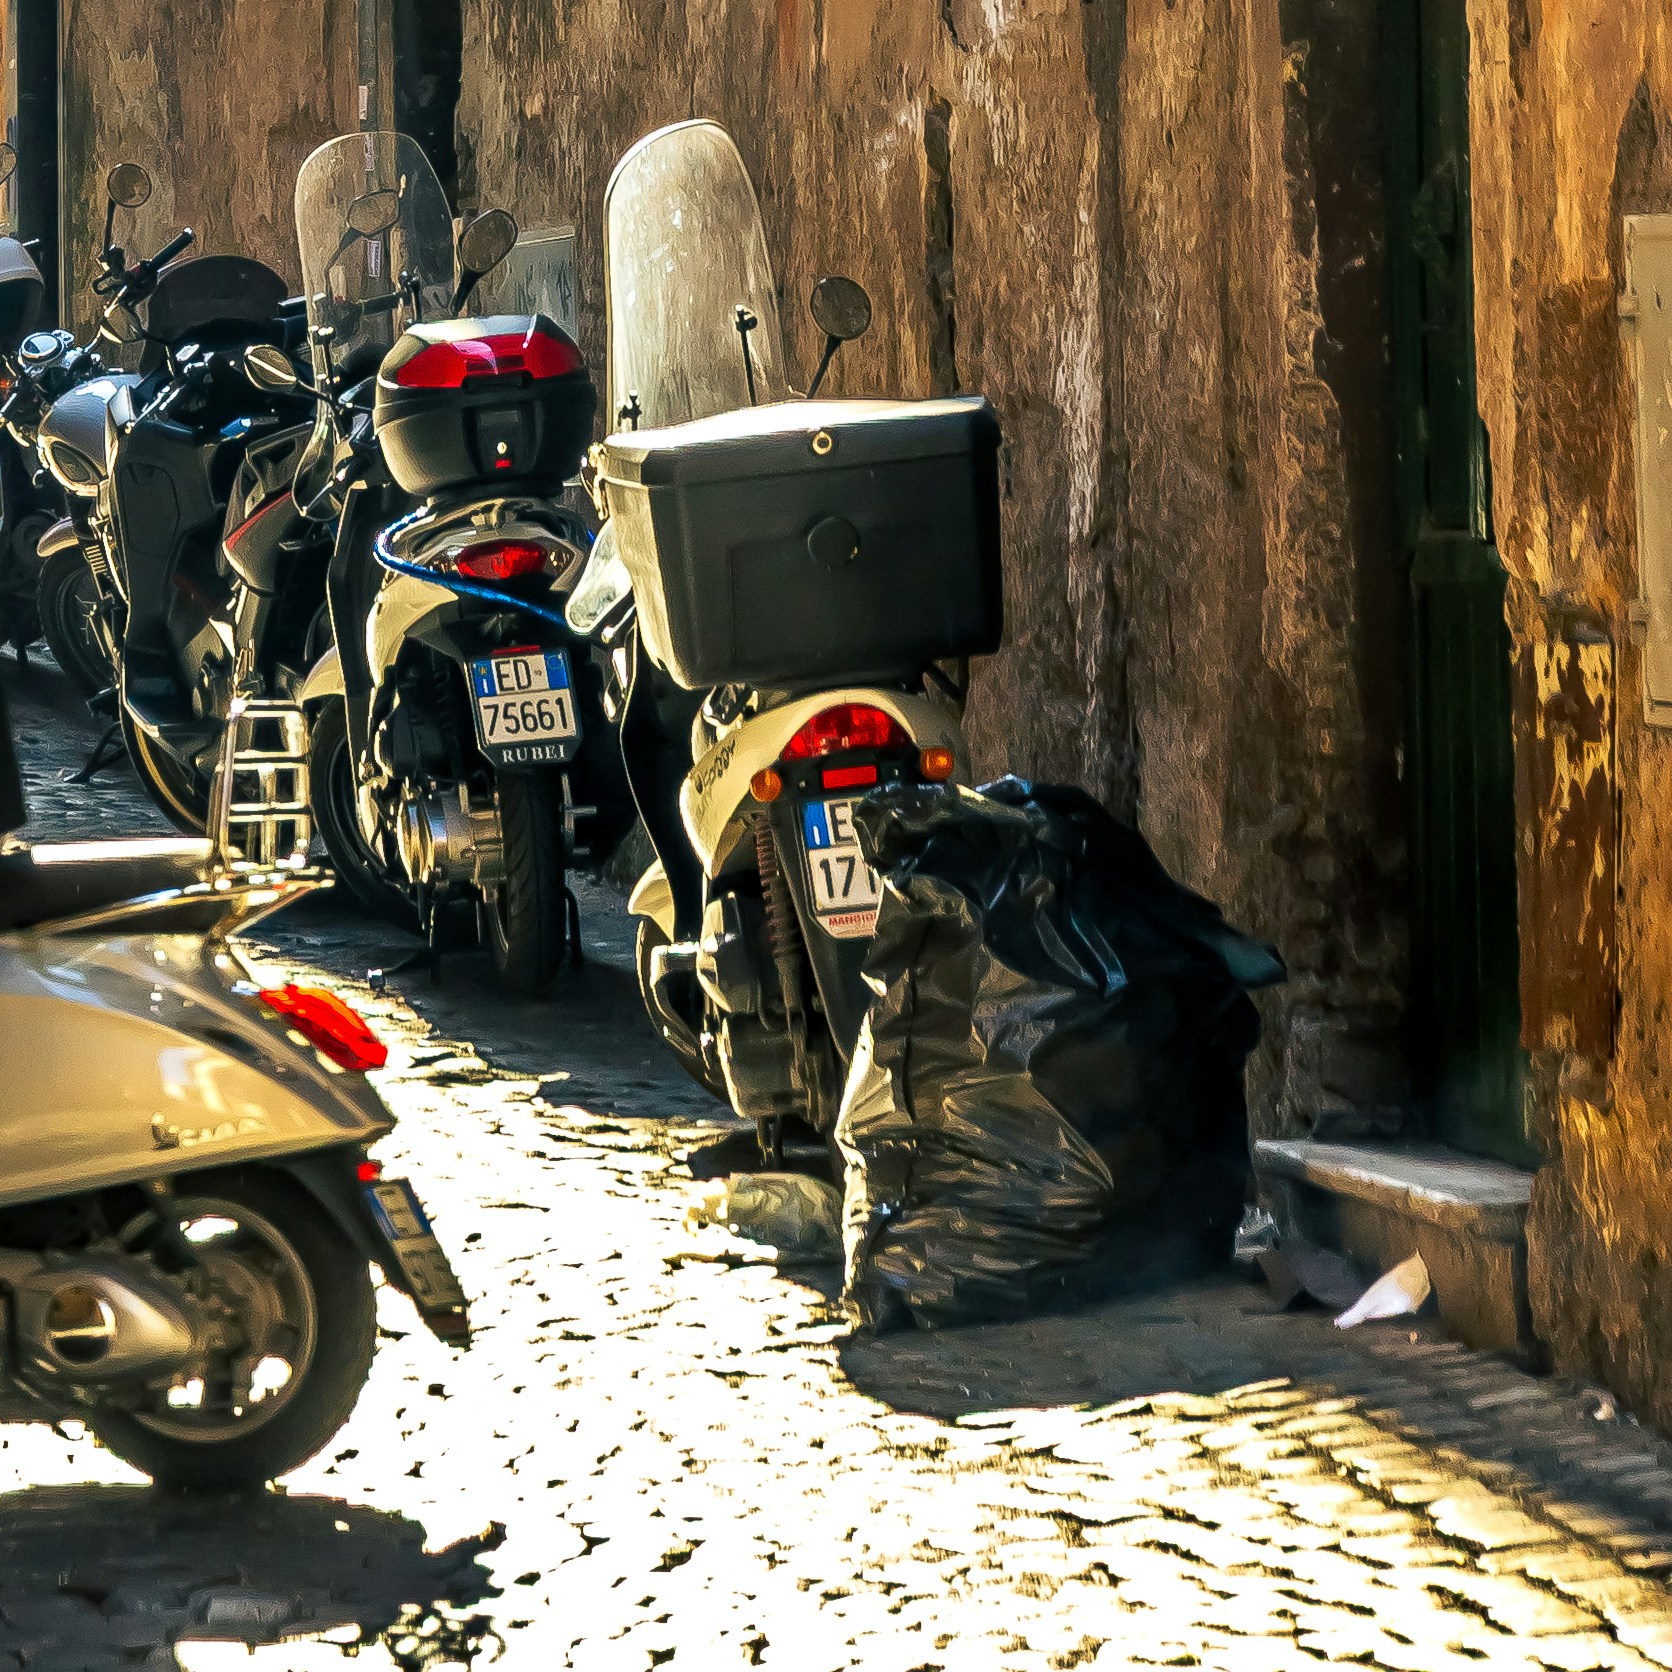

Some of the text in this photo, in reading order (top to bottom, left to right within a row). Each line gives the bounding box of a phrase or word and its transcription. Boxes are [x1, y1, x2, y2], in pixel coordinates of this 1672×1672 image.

[495, 659, 532, 691] ED
[483, 697, 567, 736] 75661
[502, 744, 565, 763] RUBEI
